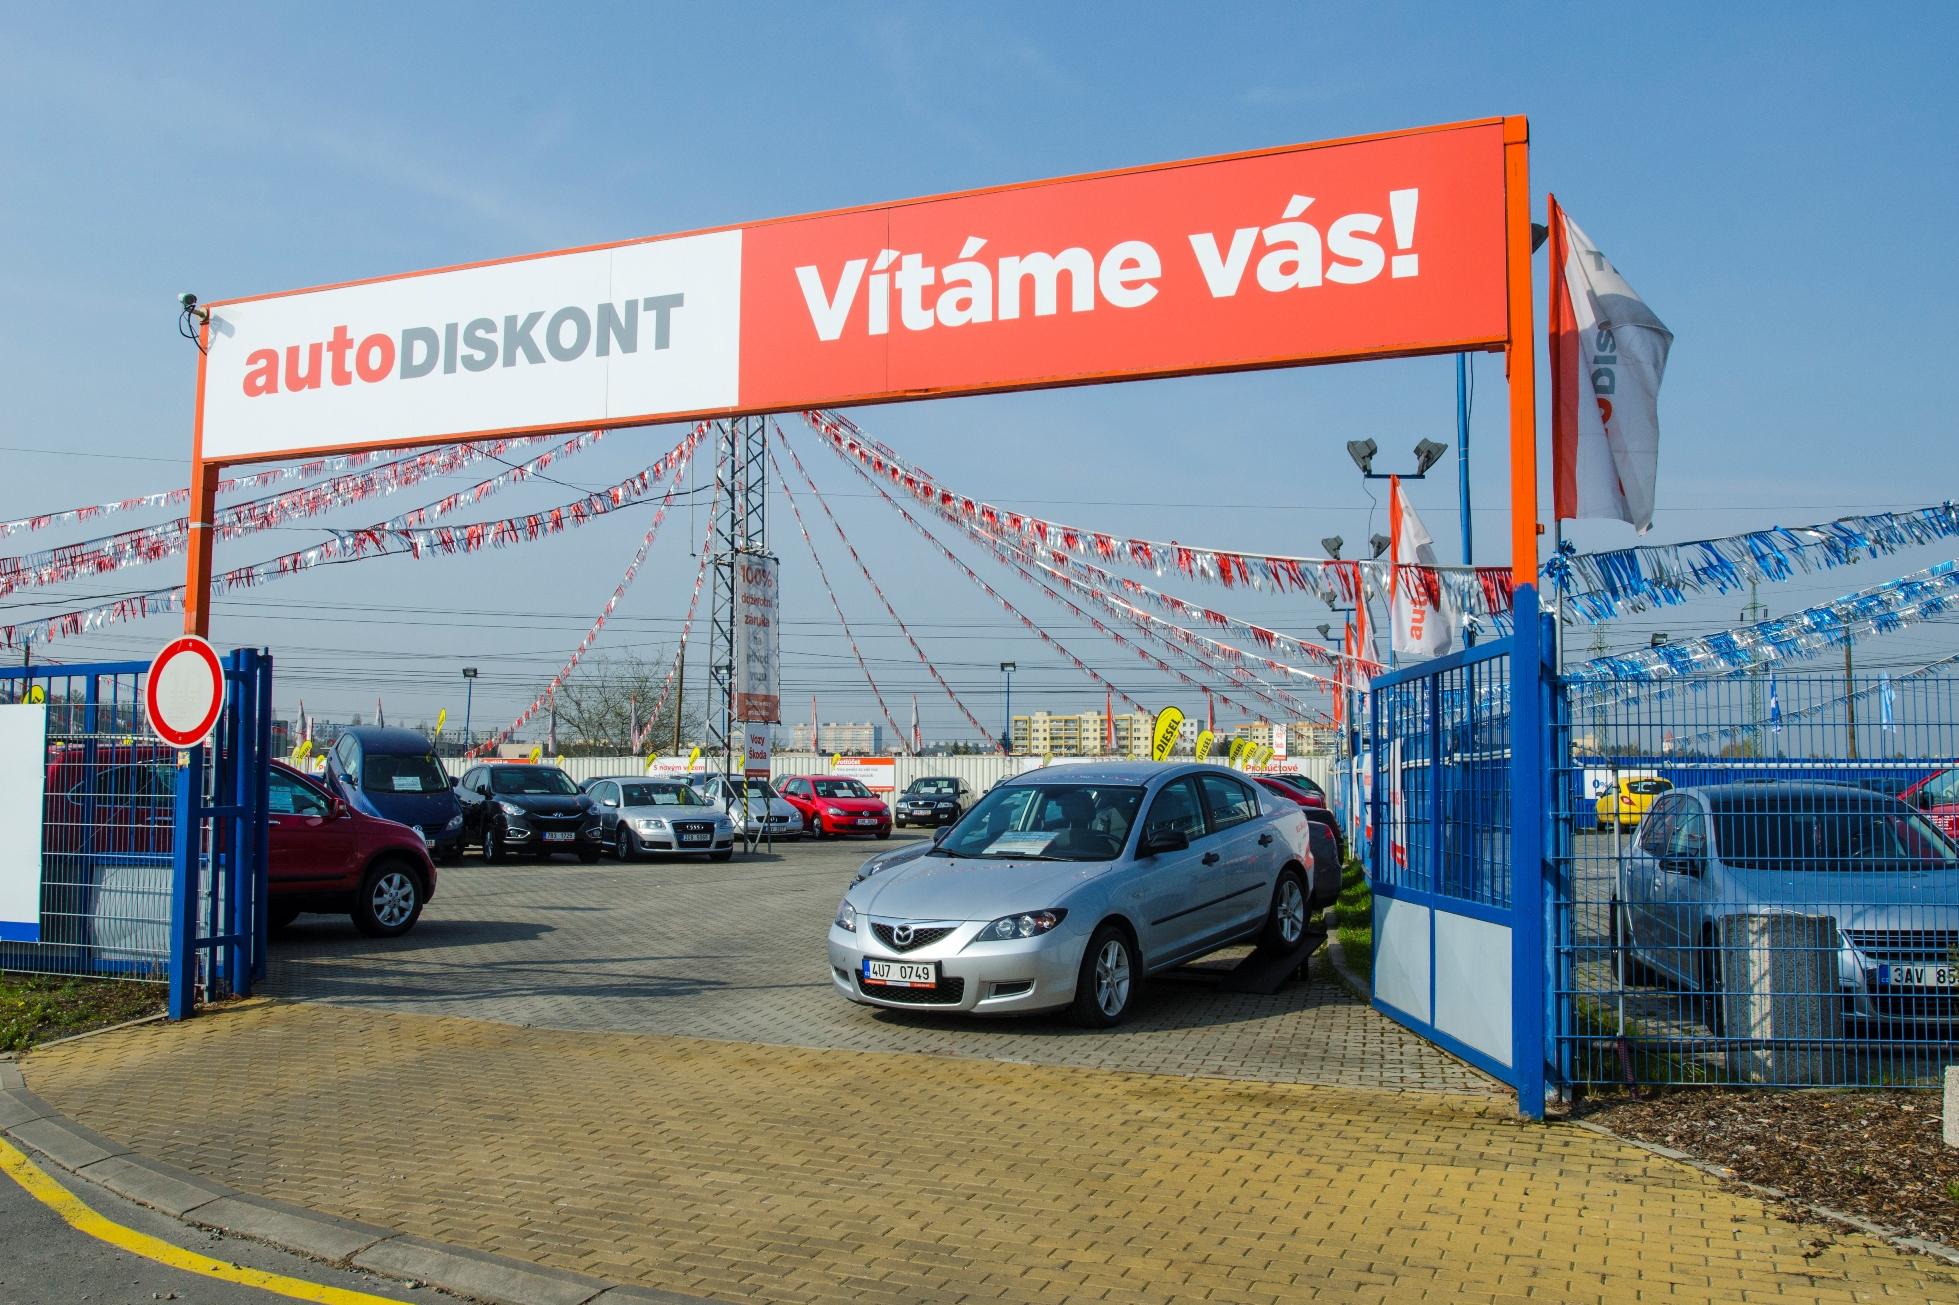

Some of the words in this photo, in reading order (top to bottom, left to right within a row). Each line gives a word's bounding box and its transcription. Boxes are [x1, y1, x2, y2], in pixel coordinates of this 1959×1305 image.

[794, 235, 1162, 342] Vítáme
[1187, 187, 1419, 300] vás!
[242, 292, 685, 398] autoDISKONT
[740, 564, 773, 588] 100%
[750, 734, 766, 747] Vozy
[1156, 719, 1181, 754] DIESEL
[748, 746, 767, 760] Škoda
[1197, 737, 1212, 761] DIESEL
[1230, 743, 1244, 761] DIESEL
[872, 963, 891, 978] 4U7
[900, 966, 930, 980] 0749
[1893, 967, 1924, 984] 3AV
[1936, 968, 1959, 985] 85
